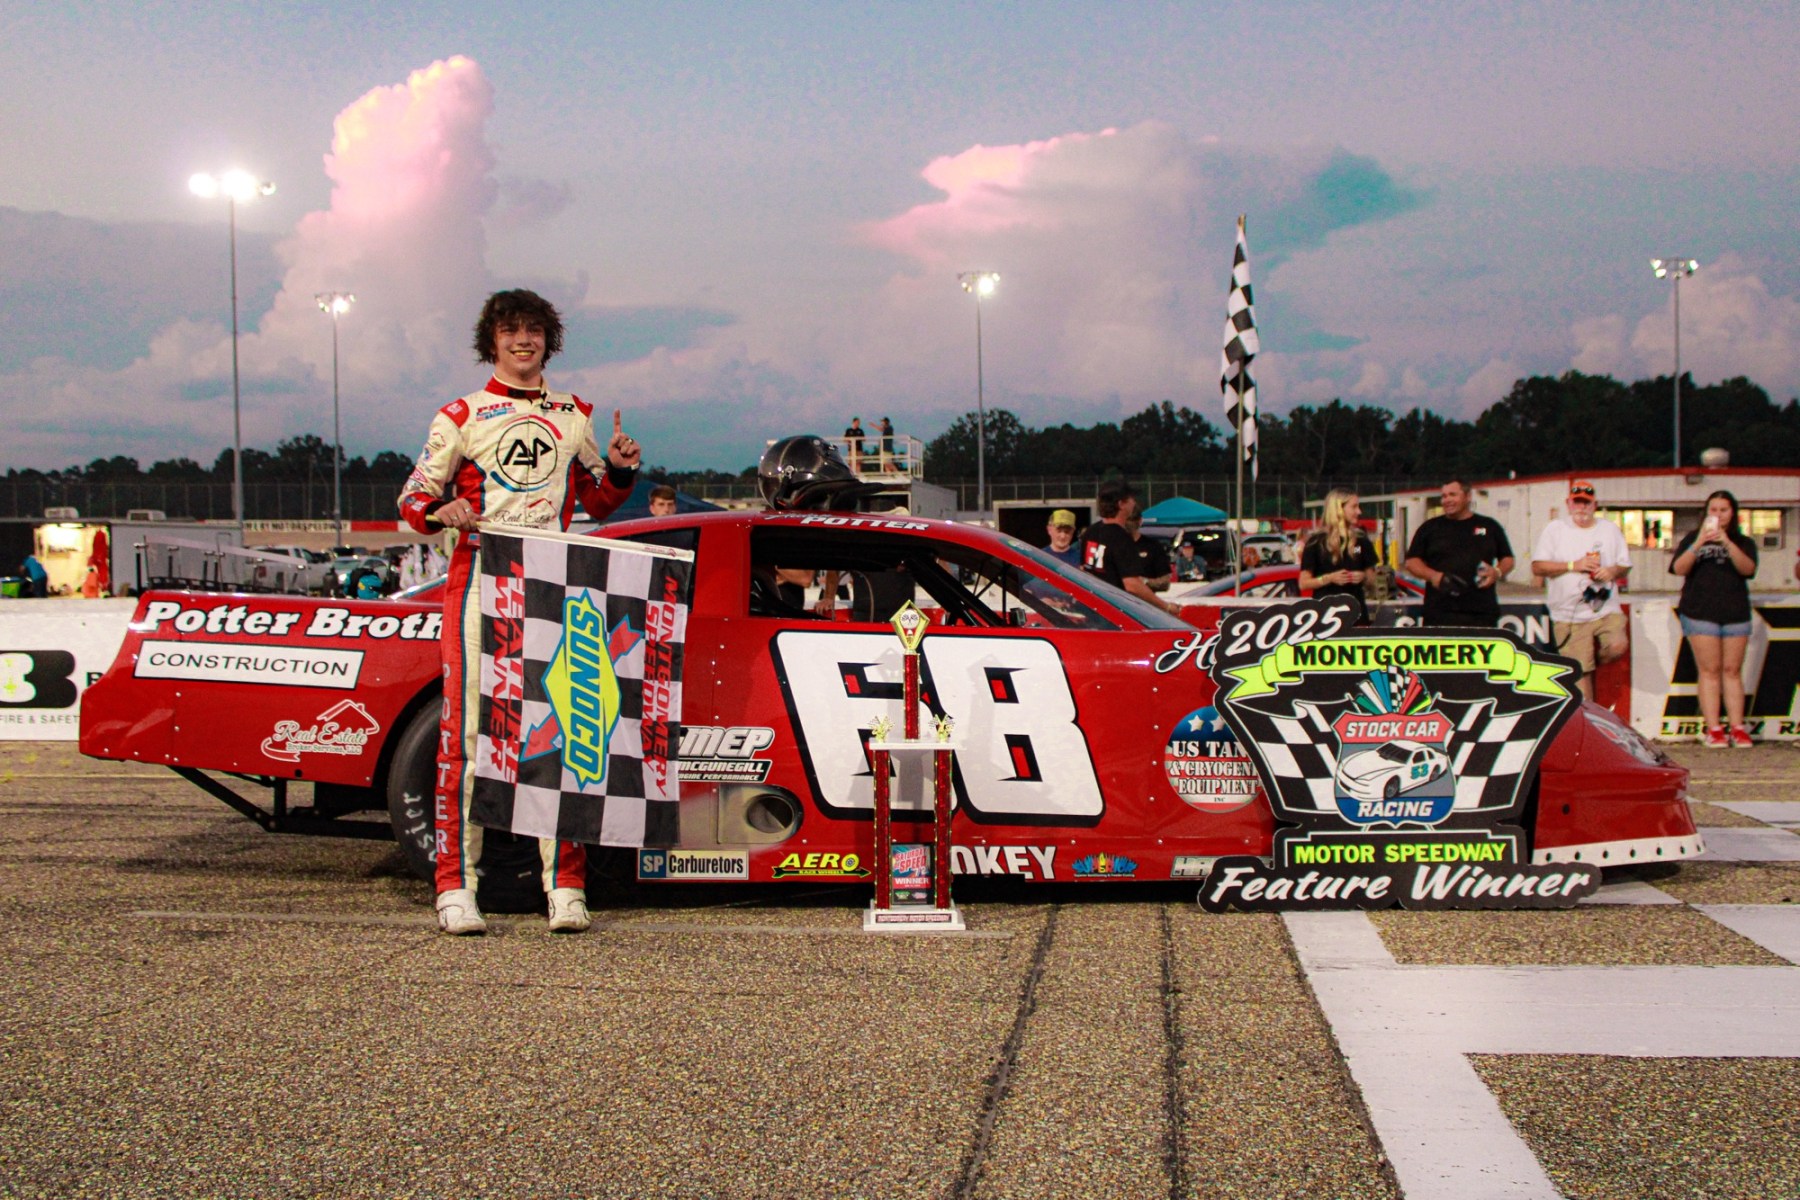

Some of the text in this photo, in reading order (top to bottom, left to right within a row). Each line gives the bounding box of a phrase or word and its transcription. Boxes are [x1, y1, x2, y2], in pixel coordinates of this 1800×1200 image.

[801, 516, 930, 531] POTTER
[147, 601, 442, 640] Potter Broth
[1224, 603, 1351, 657] 2025
[150, 652, 349, 676] CONSTRUCTION
[1293, 643, 1496, 667] MONTGOMERY
[490, 575, 509, 772] WINNER
[504, 560, 525, 785] FEATURE
[569, 607, 601, 774] SUNOCO
[641, 602, 660, 772] SPEEDWAY
[653, 576, 679, 797] MONTGOMERY
[40, 714, 80, 724] SAFET
[776, 631, 1104, 816] 68
[1346, 720, 1440, 738] STOCK CAR
[273, 720, 368, 745] Real Estate
[678, 727, 774, 757] MEP
[435, 663, 452, 854] POTTER
[1171, 741, 1248, 757] US TAN
[1170, 761, 1259, 776] & CRYOGENI
[1410, 762, 1430, 779] 53
[1178, 779, 1258, 794] EQUIPMENT
[1358, 800, 1434, 818] RACING
[642, 854, 744, 875] SP Carburetors
[779, 853, 860, 871] AERO
[900, 855, 927, 873] SPEED
[950, 846, 1056, 879] OKEY
[1295, 843, 1507, 864] MOTOR SPEEDWAY
[895, 877, 930, 885] WINNER
[1210, 867, 1392, 903] Feature
[1411, 865, 1591, 901] Winner
